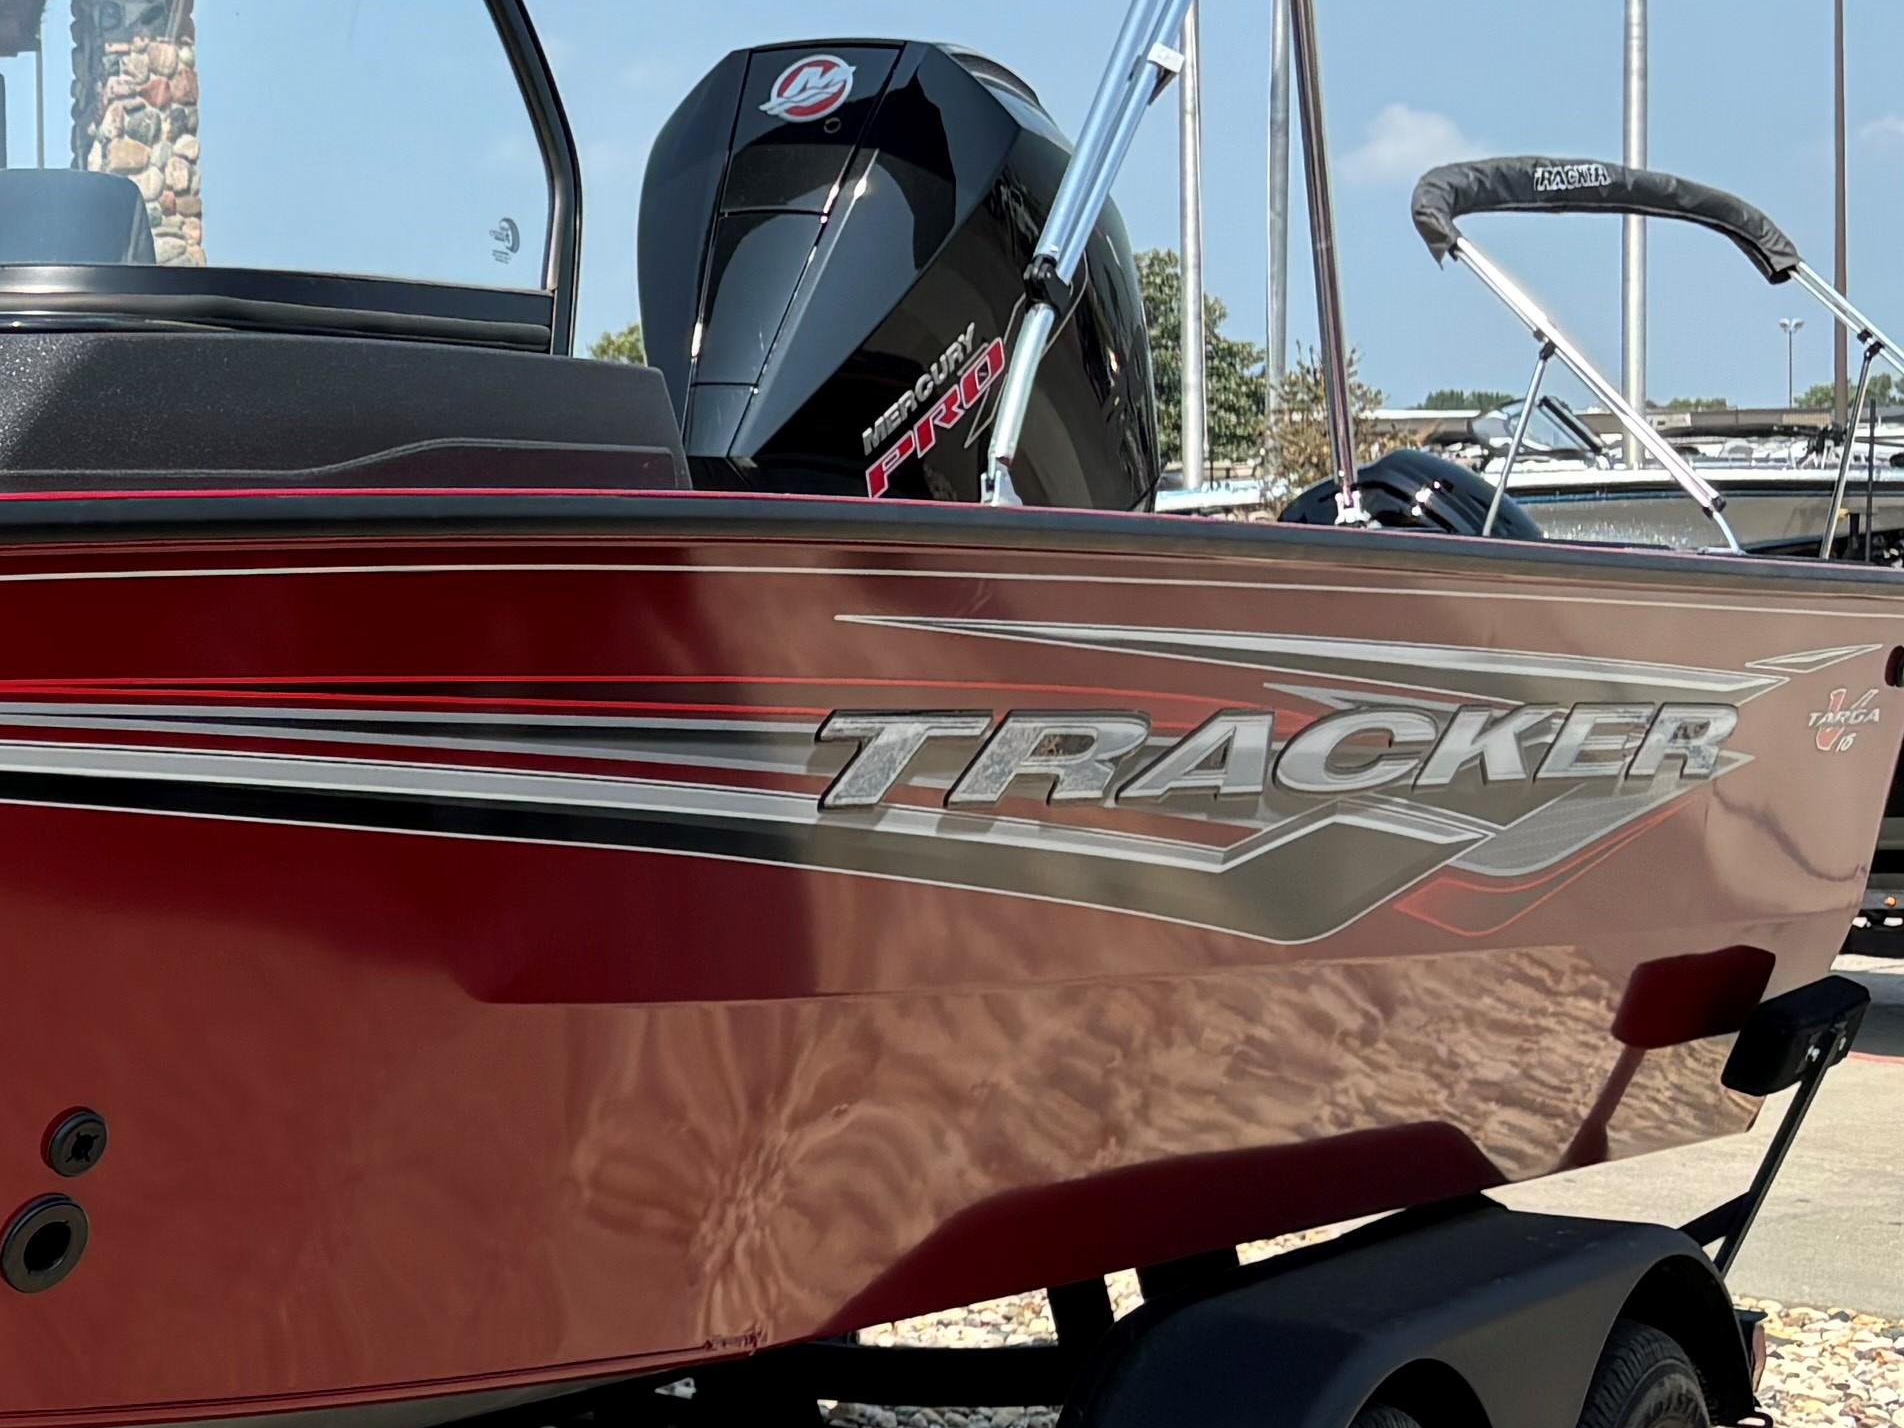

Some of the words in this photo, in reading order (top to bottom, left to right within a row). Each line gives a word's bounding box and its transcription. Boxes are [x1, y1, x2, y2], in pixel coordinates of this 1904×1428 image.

[862, 322, 975, 456] MERCURY
[865, 337, 1005, 499] PRO
[816, 700, 1740, 811] TRACKER
